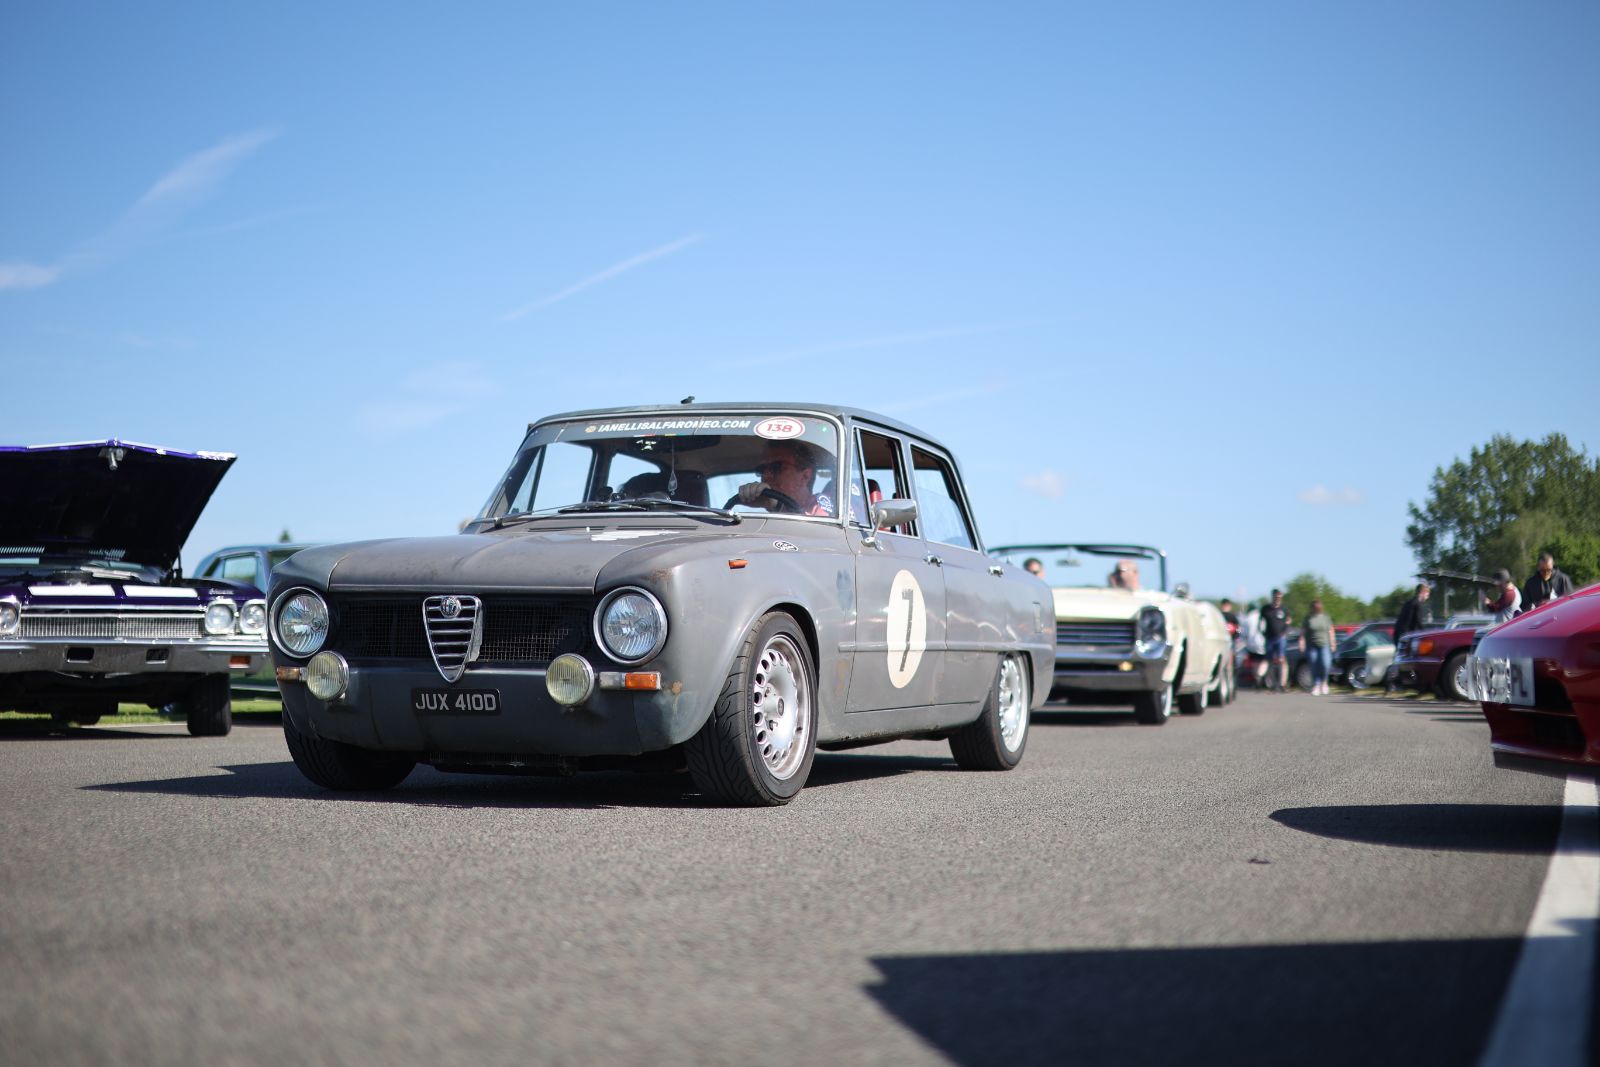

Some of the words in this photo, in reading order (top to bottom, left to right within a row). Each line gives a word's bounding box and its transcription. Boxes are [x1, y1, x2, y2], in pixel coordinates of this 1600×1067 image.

[597, 420, 751, 433] IANELLISALFAROMEO.COM
[766, 423, 793, 433] 138
[899, 588, 914, 672] 7
[415, 693, 450, 711] JUX
[454, 693, 497, 711] 410D
